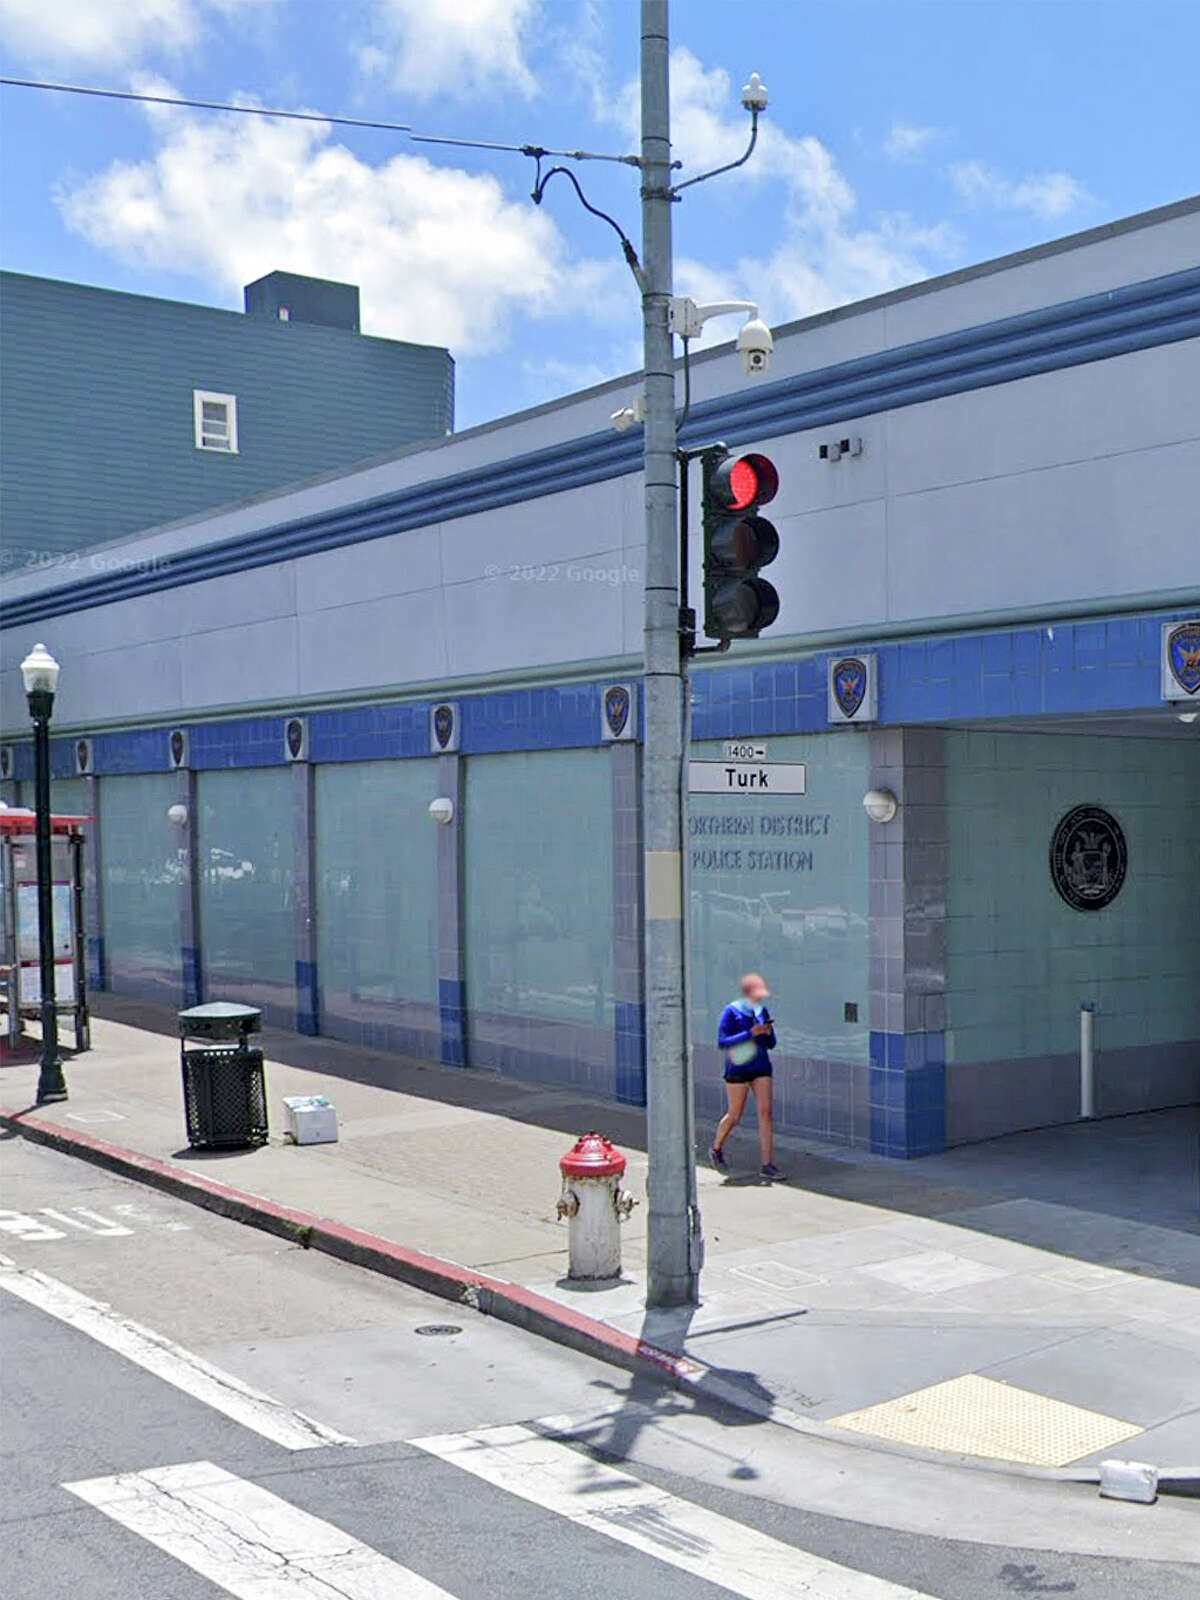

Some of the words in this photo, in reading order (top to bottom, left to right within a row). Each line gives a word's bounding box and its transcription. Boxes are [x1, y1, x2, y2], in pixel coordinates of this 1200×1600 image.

[728, 745, 754, 758] 1400
[725, 768, 768, 787] Turk
[689, 815, 754, 836] ORTHERN
[761, 814, 830, 837] DISTRICT
[693, 849, 742, 871] POLICE
[748, 850, 813, 872] STATION
